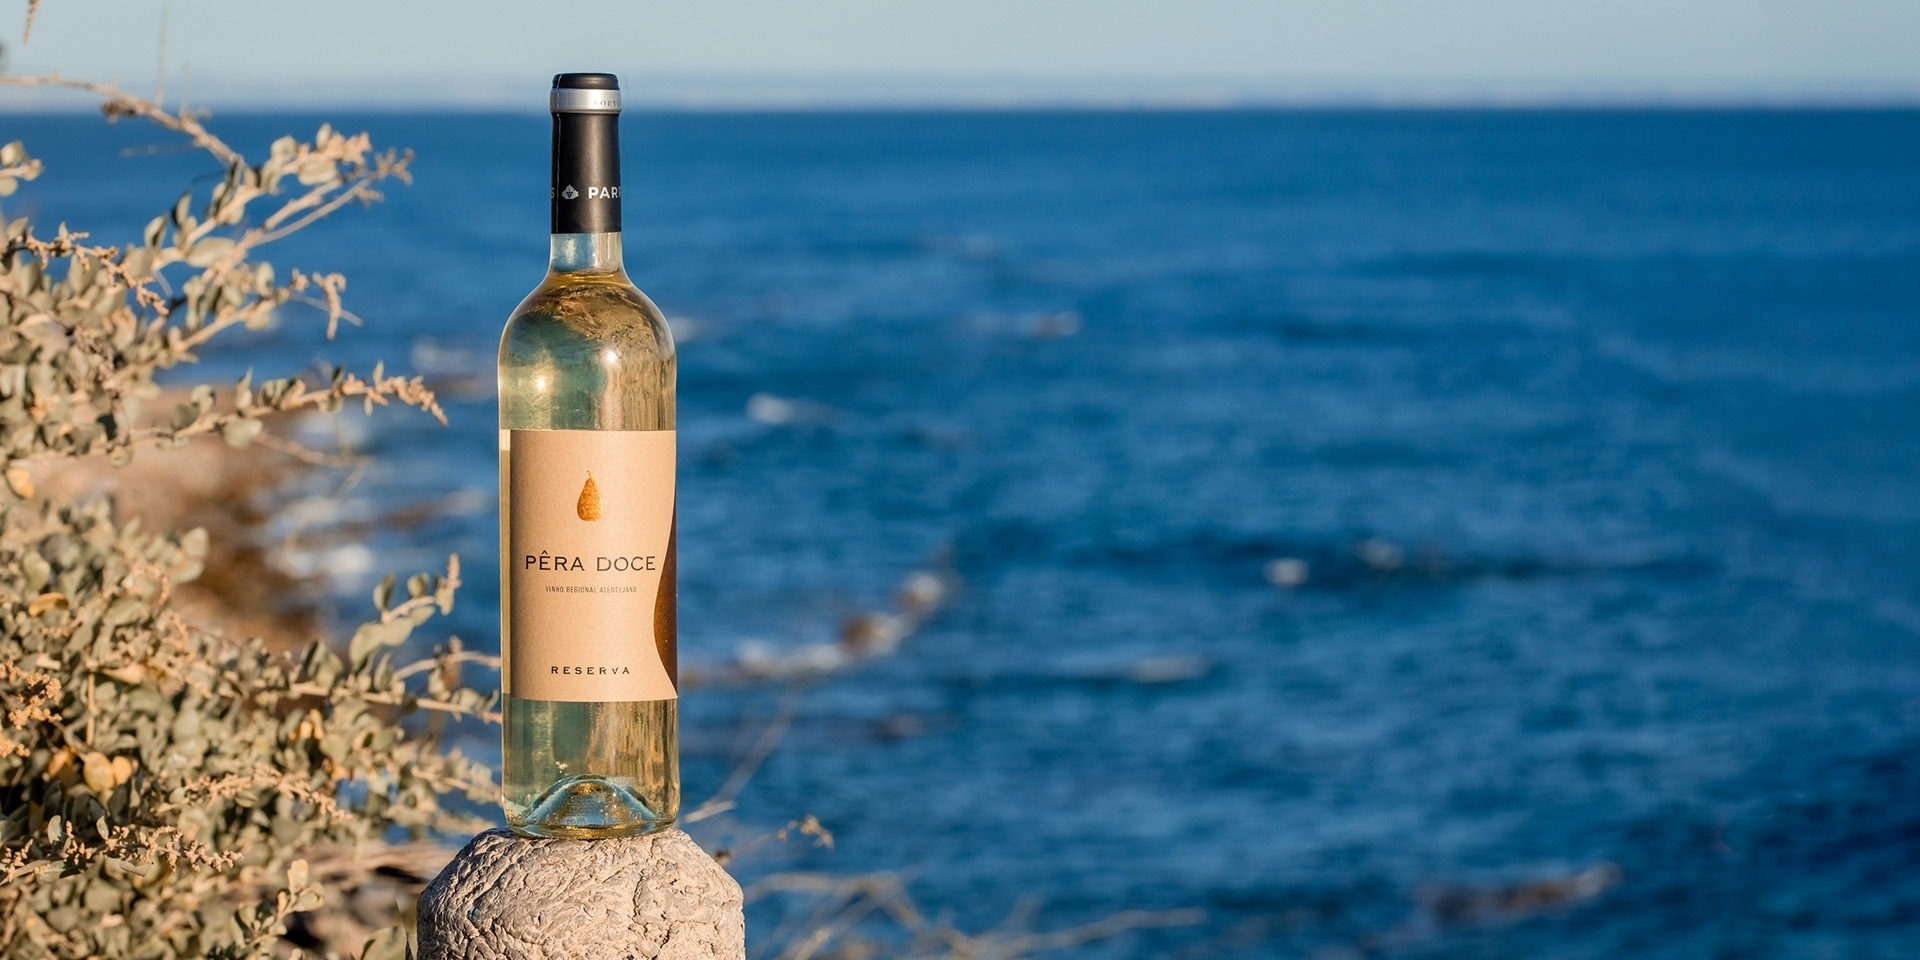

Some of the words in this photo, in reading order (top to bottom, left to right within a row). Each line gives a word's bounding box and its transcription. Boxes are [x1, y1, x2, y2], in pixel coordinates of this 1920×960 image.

[525, 550, 585, 572] PÊRA
[596, 556, 656, 572] DOCE
[566, 586, 598, 594] REGIONAL
[600, 586, 637, 594] ALENTEJANO
[551, 666, 630, 675] RESERVA
